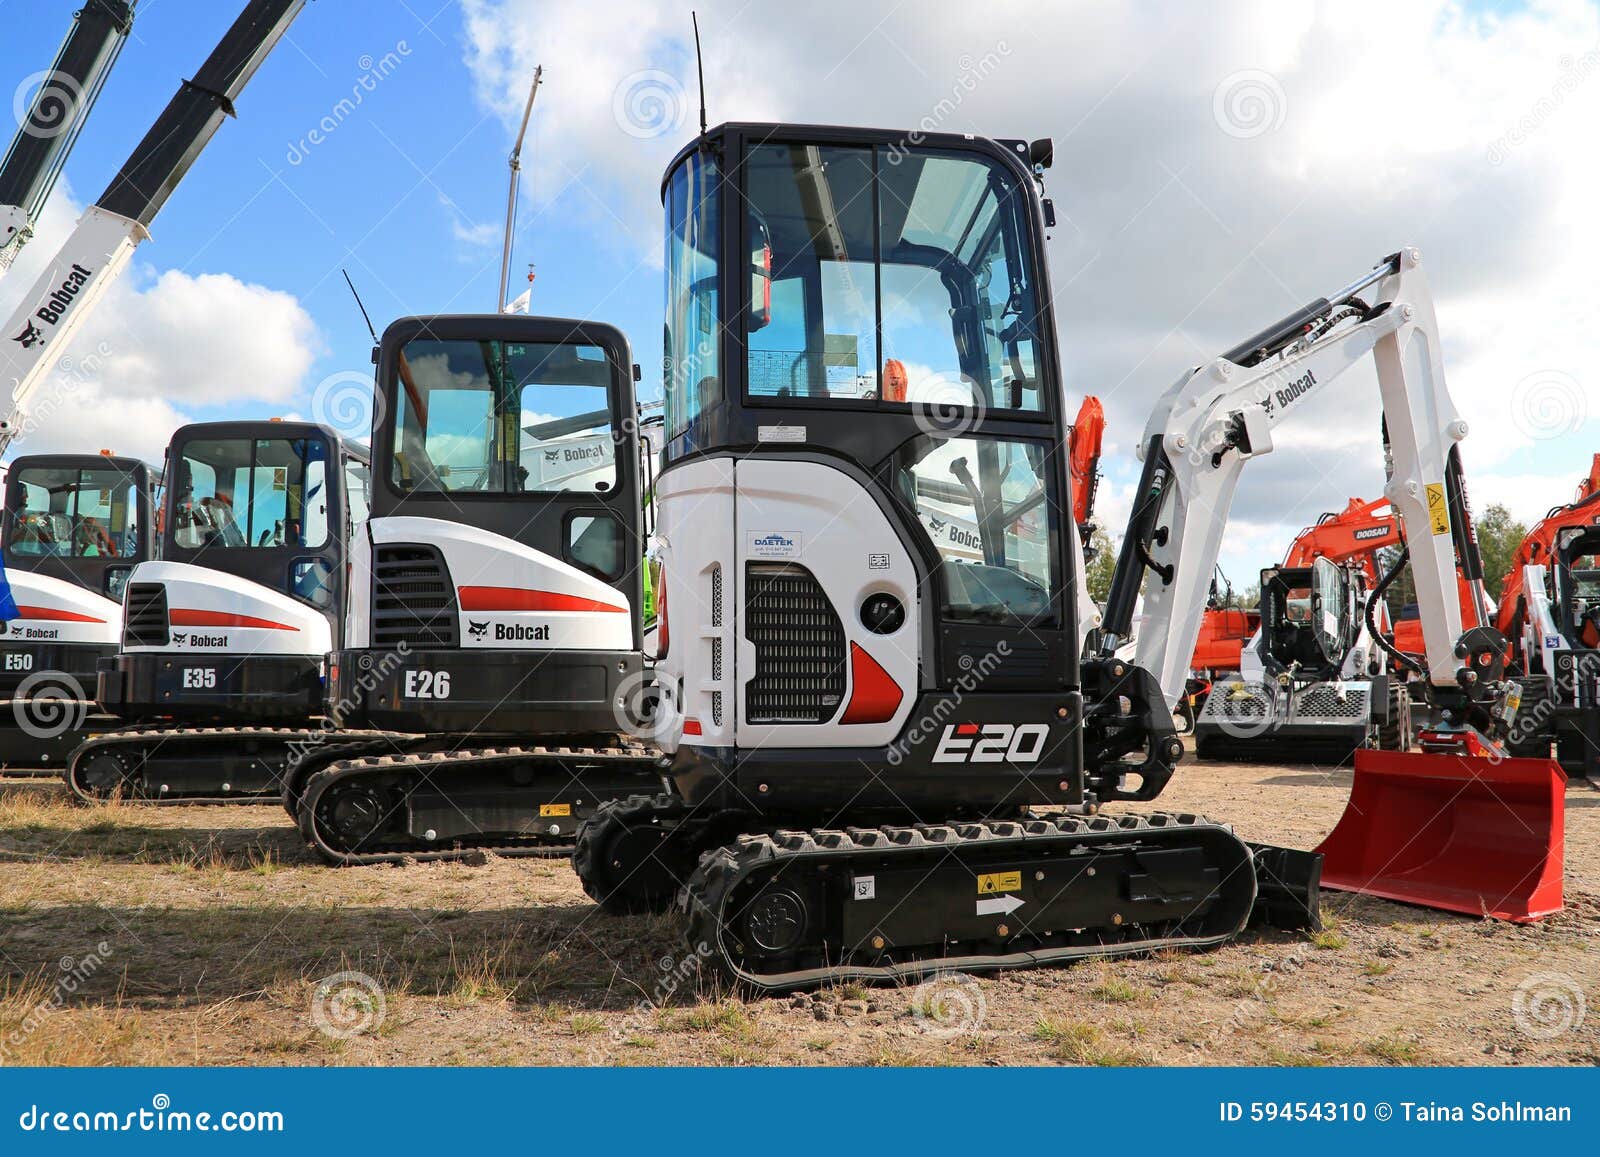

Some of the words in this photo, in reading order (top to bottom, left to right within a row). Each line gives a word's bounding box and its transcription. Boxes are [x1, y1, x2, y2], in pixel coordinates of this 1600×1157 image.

[36, 263, 92, 325] Bobcat
[1275, 369, 1317, 408] Bobcat
[564, 444, 604, 461] Bobcat
[949, 525, 985, 550] Bobca
[1356, 526, 1388, 539] DOOSAN
[26, 628, 59, 639] Bobcat
[190, 635, 228, 647] Bobcat
[495, 624, 550, 640] Bobcat
[5, 654, 33, 671] E50
[183, 668, 216, 688] E35
[404, 670, 451, 699] E26
[931, 723, 1050, 763] E20
